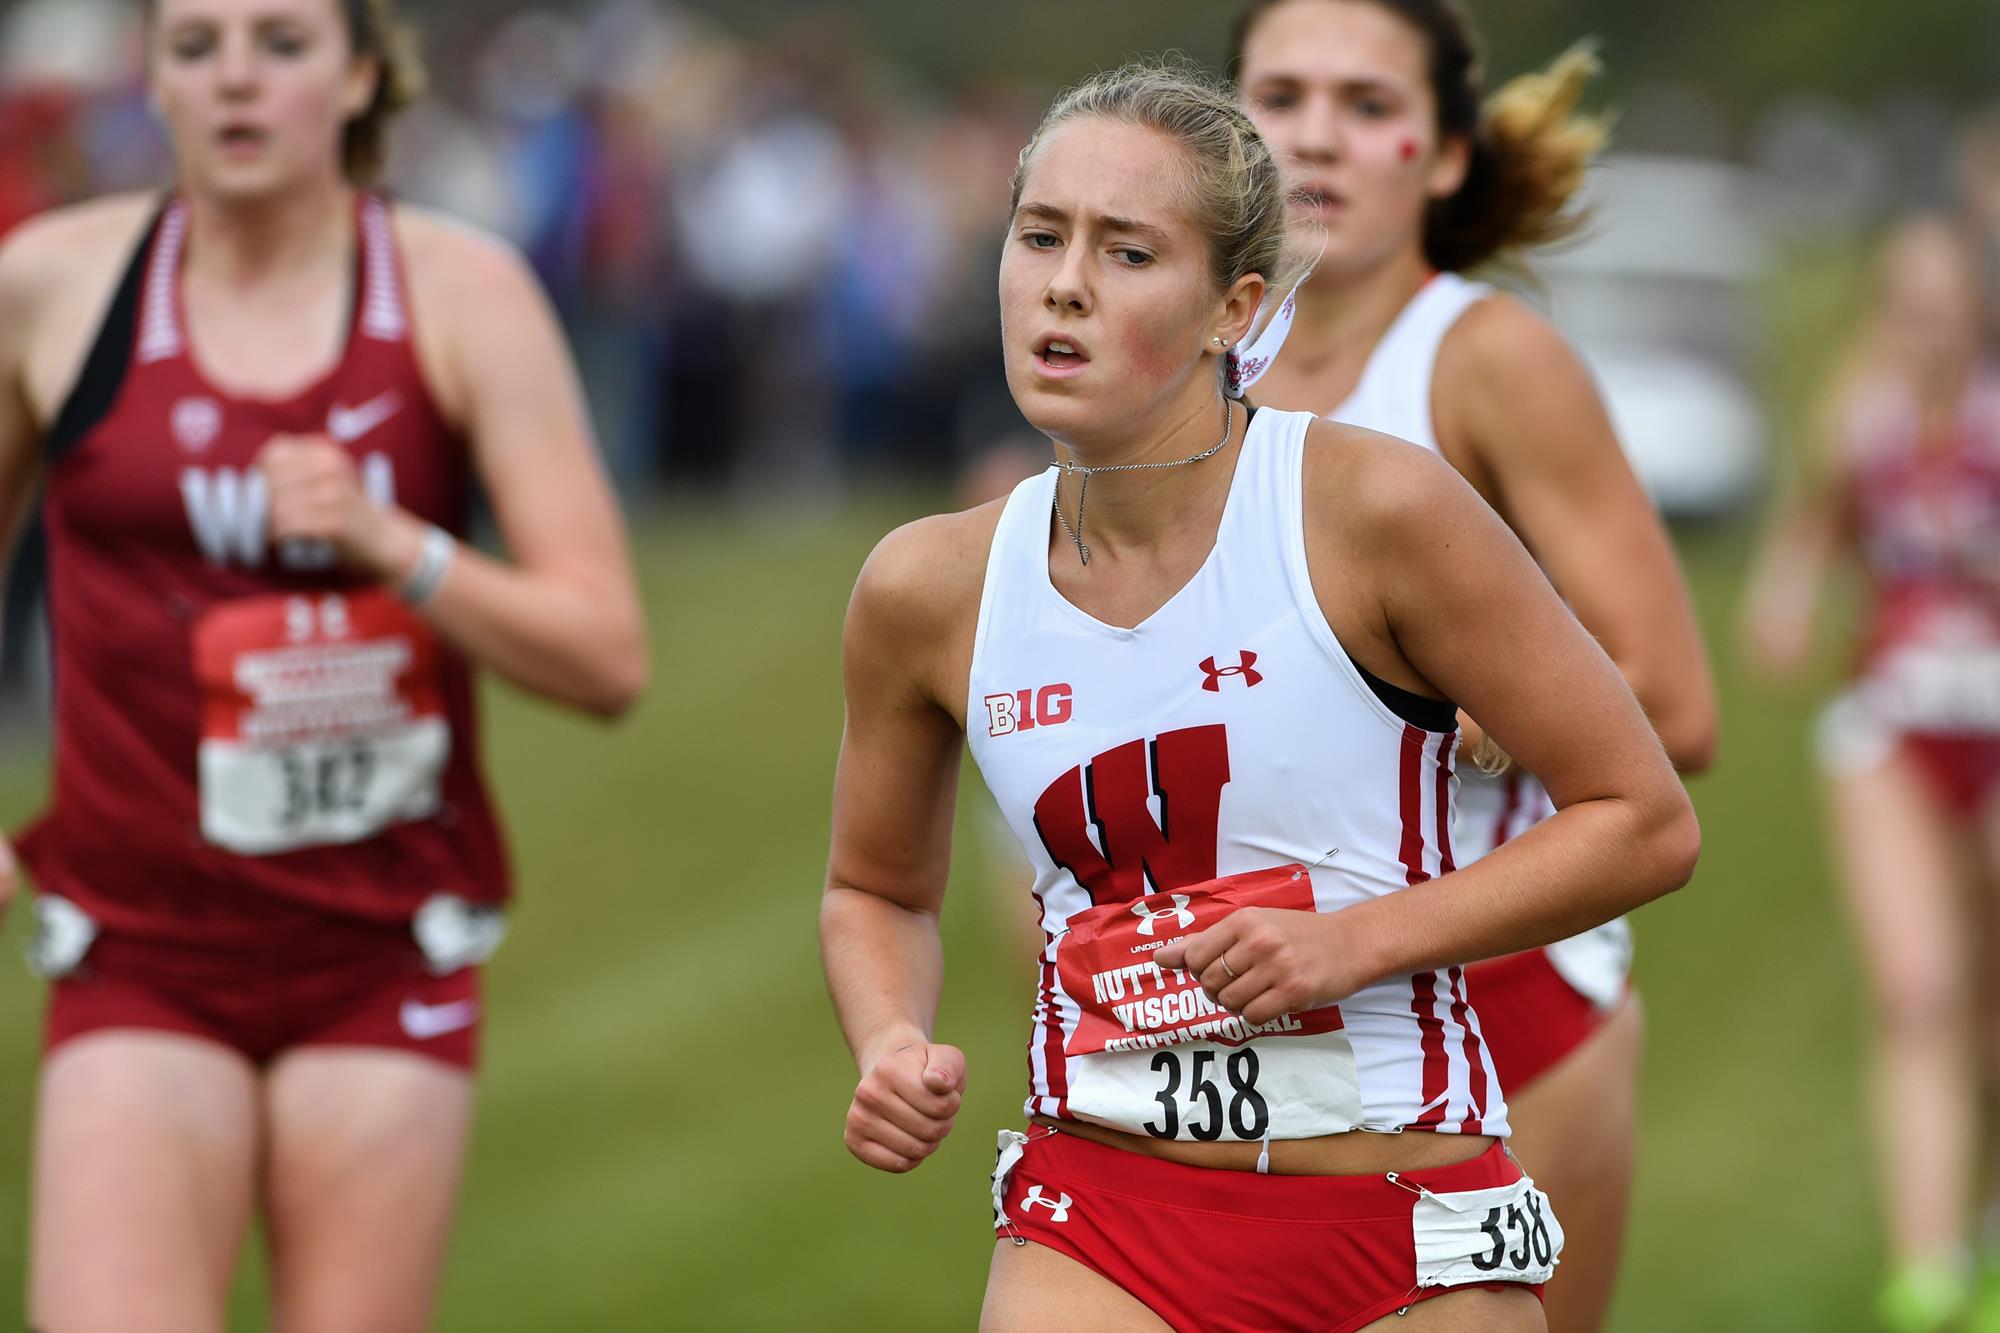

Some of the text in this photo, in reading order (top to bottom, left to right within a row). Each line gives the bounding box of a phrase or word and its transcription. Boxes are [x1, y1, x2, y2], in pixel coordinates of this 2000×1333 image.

[1033, 723, 1231, 906] W
[1130, 940, 1164, 954] UNDER
[1143, 1046, 1270, 1141] 358
[1471, 1189, 1552, 1271] 358
